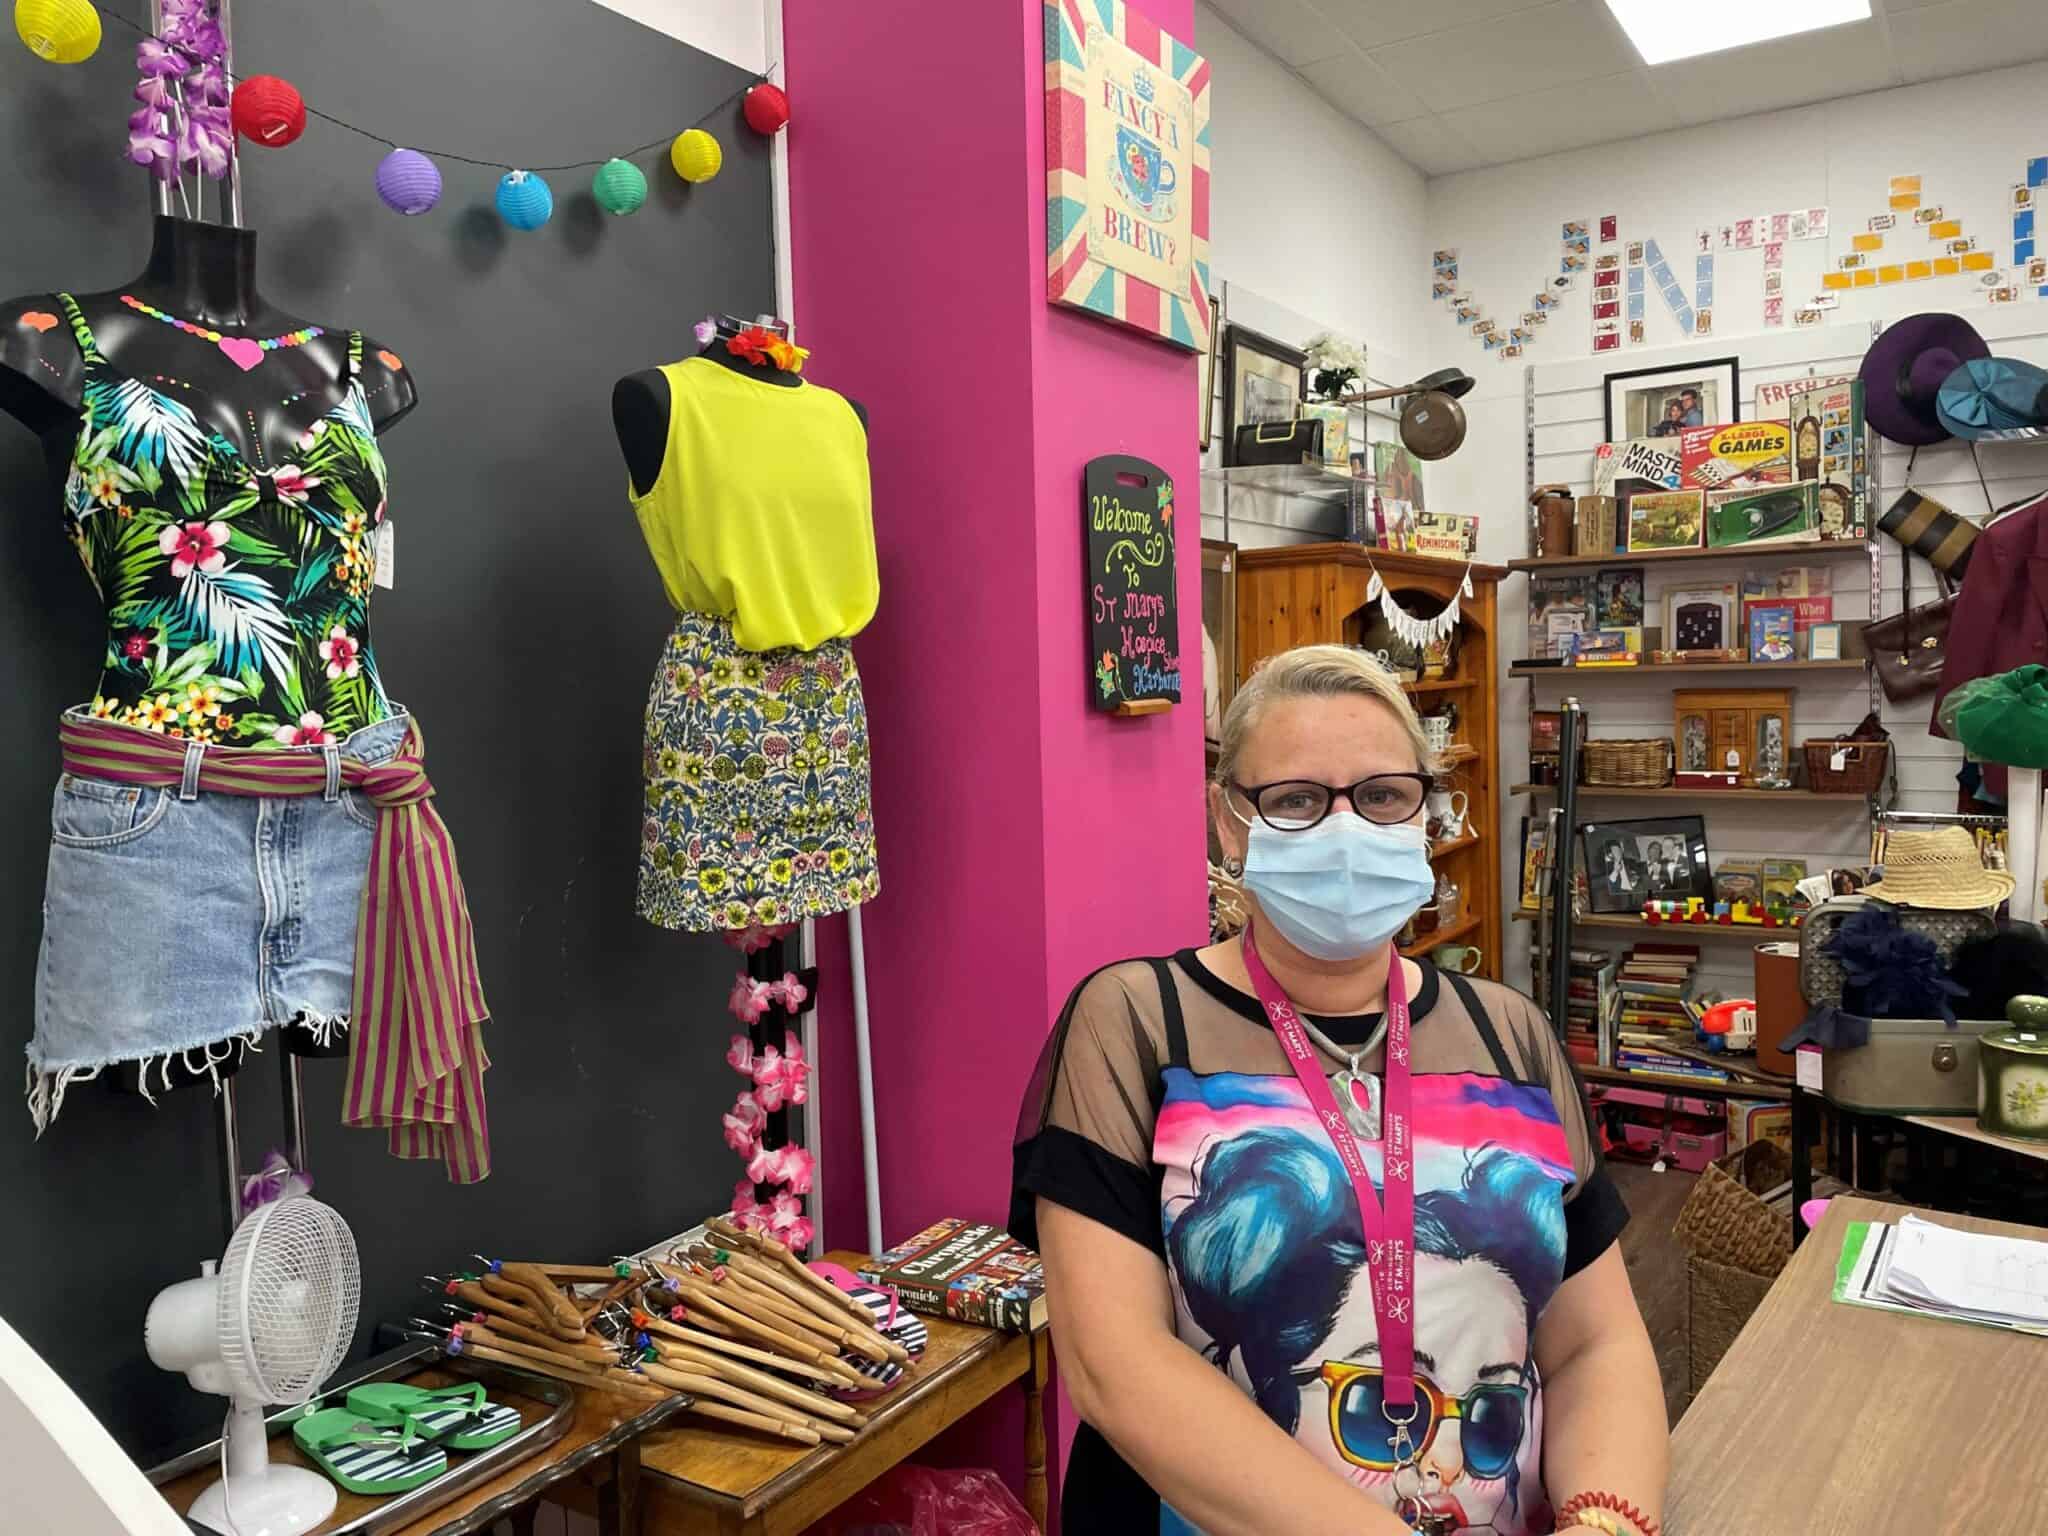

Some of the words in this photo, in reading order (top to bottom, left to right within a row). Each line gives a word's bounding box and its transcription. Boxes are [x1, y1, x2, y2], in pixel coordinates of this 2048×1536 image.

[1103, 79, 1165, 140] FANCY
[1166, 110, 1180, 150] A
[1103, 203, 1176, 267] BREW?
[1760, 381, 1818, 406] FRESH
[1718, 436, 1785, 454] GAMES
[1622, 455, 1664, 482] MIND
[1629, 443, 1682, 475] MASTE
[1092, 495, 1152, 534] Welcome
[1123, 563, 1140, 588] To
[1798, 602, 1825, 616] When
[899, 1224, 993, 1275] Chronicle
[1394, 1279, 1404, 1292] ST
